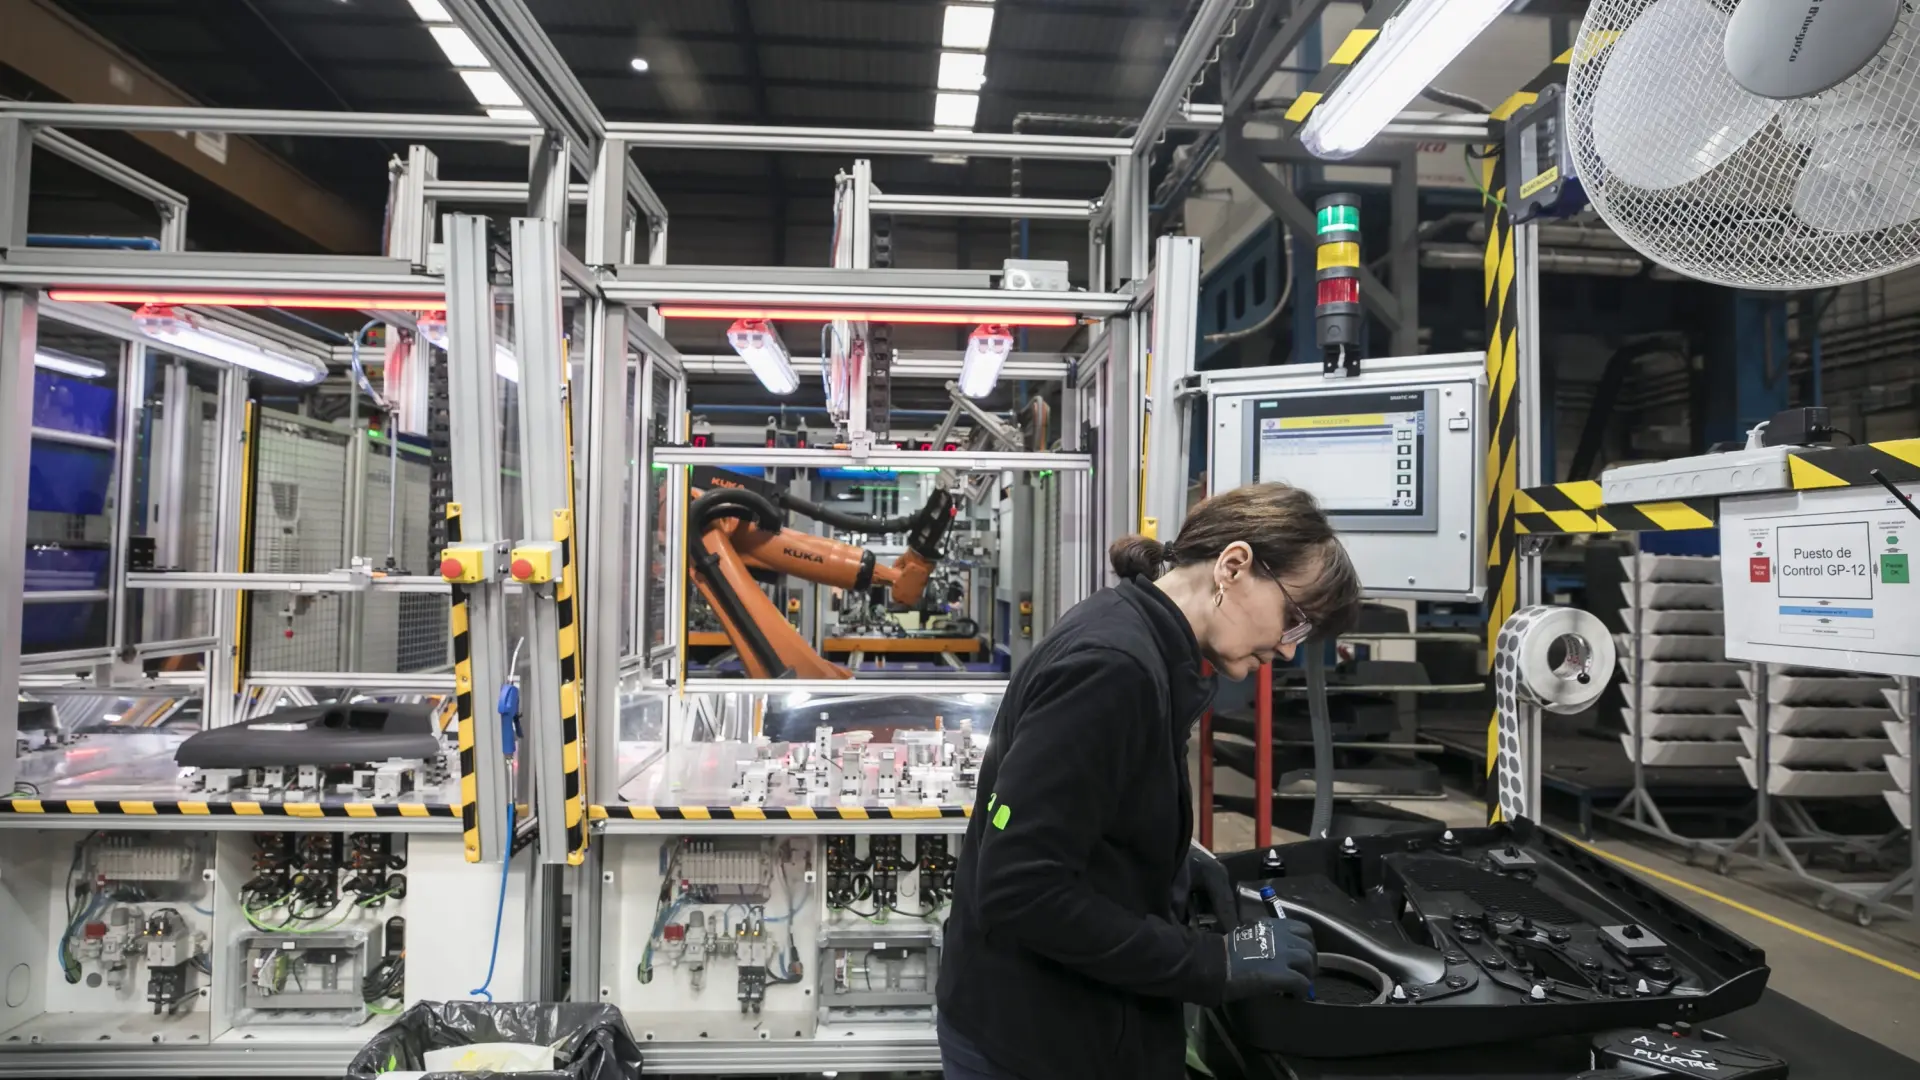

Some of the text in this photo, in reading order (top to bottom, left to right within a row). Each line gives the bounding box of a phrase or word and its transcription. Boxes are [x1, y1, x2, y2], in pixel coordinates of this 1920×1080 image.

[711, 477, 745, 490] KUKA
[783, 548, 824, 564] KUKA
[1794, 547, 1851, 559] Puesto de
[1782, 564, 1866, 576] Control GP-12
[1631, 1035, 1656, 1046] A
[1681, 1049, 1709, 1058] S
[1634, 1048, 1719, 1070] PUERTAS
